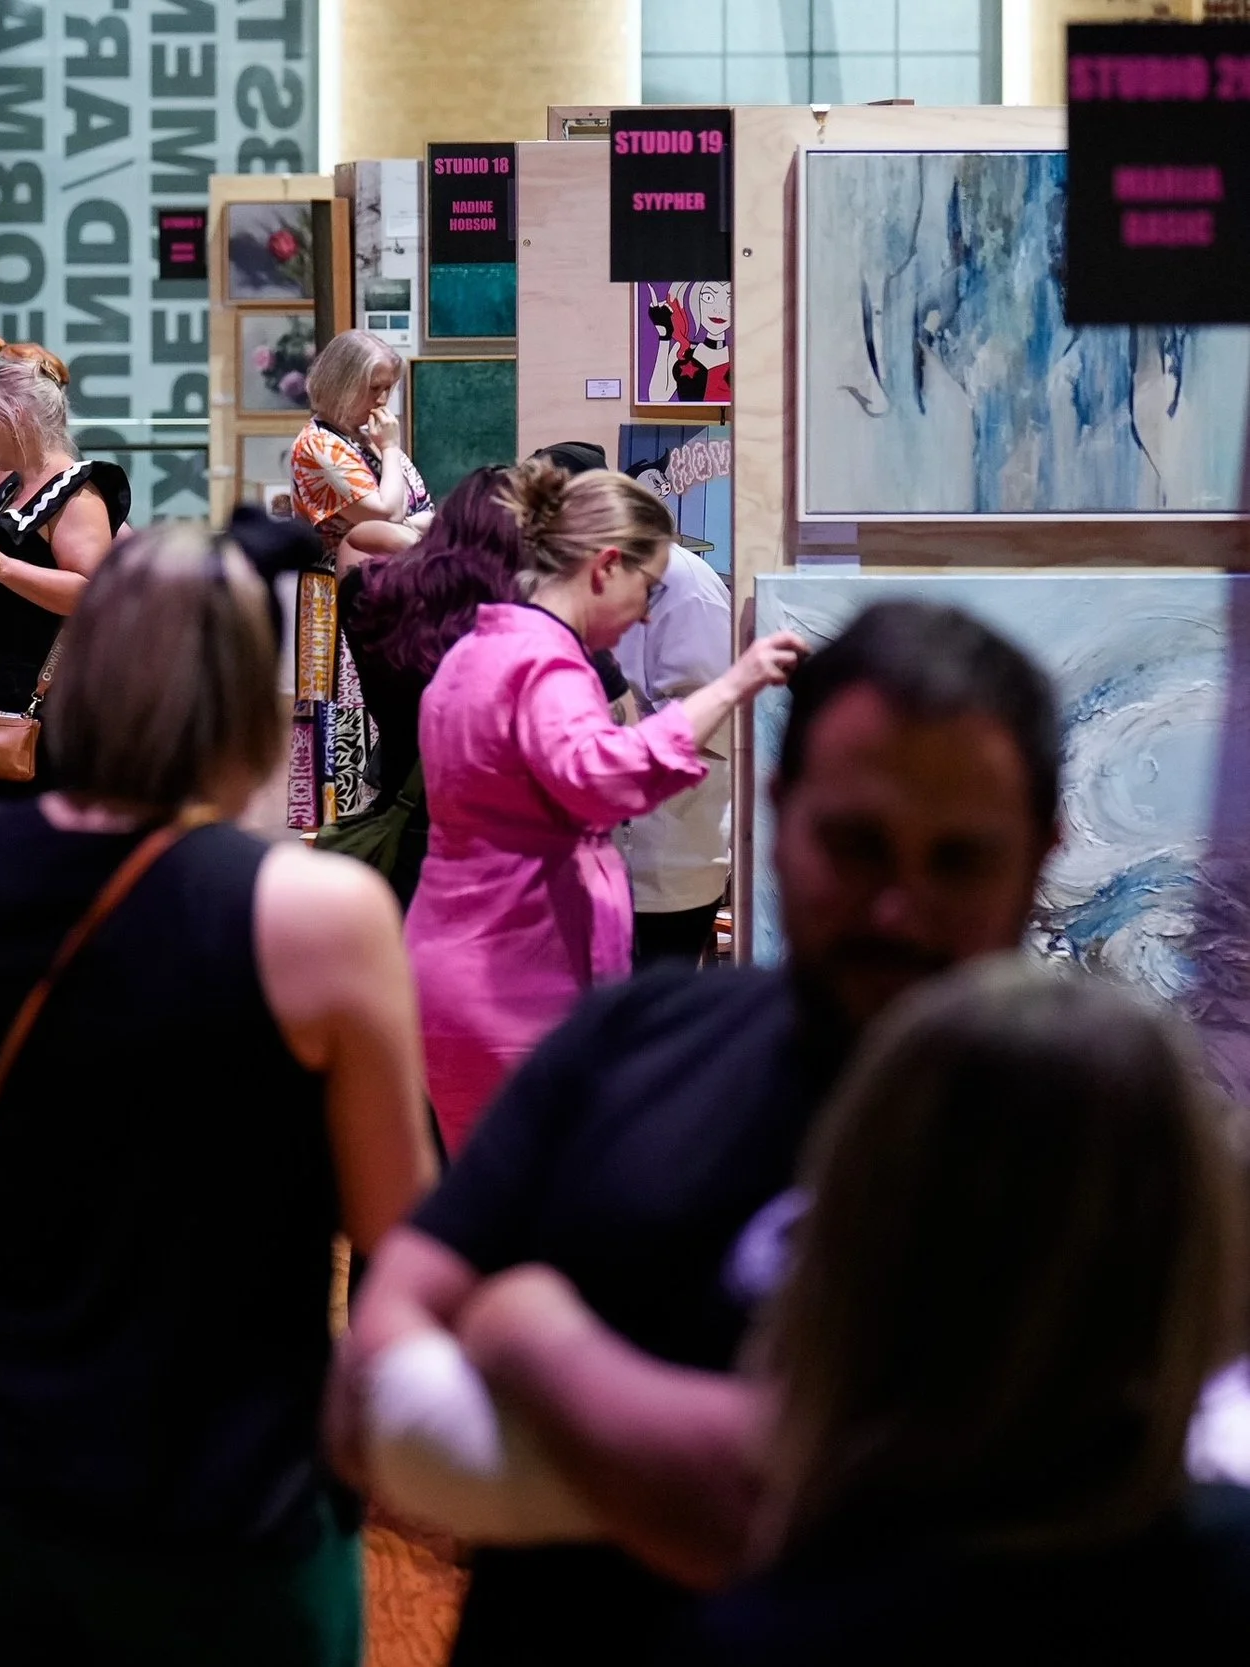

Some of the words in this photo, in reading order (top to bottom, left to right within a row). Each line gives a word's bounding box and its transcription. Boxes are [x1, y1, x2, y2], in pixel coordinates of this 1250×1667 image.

[614, 130, 694, 154] STUDIO
[697, 130, 723, 154] 19
[434, 157, 489, 175] STUDIO
[491, 157, 510, 174] 18
[452, 201, 495, 214] NADINE
[633, 192, 707, 212] SYYPHER
[449, 217, 498, 232] HOBSON
